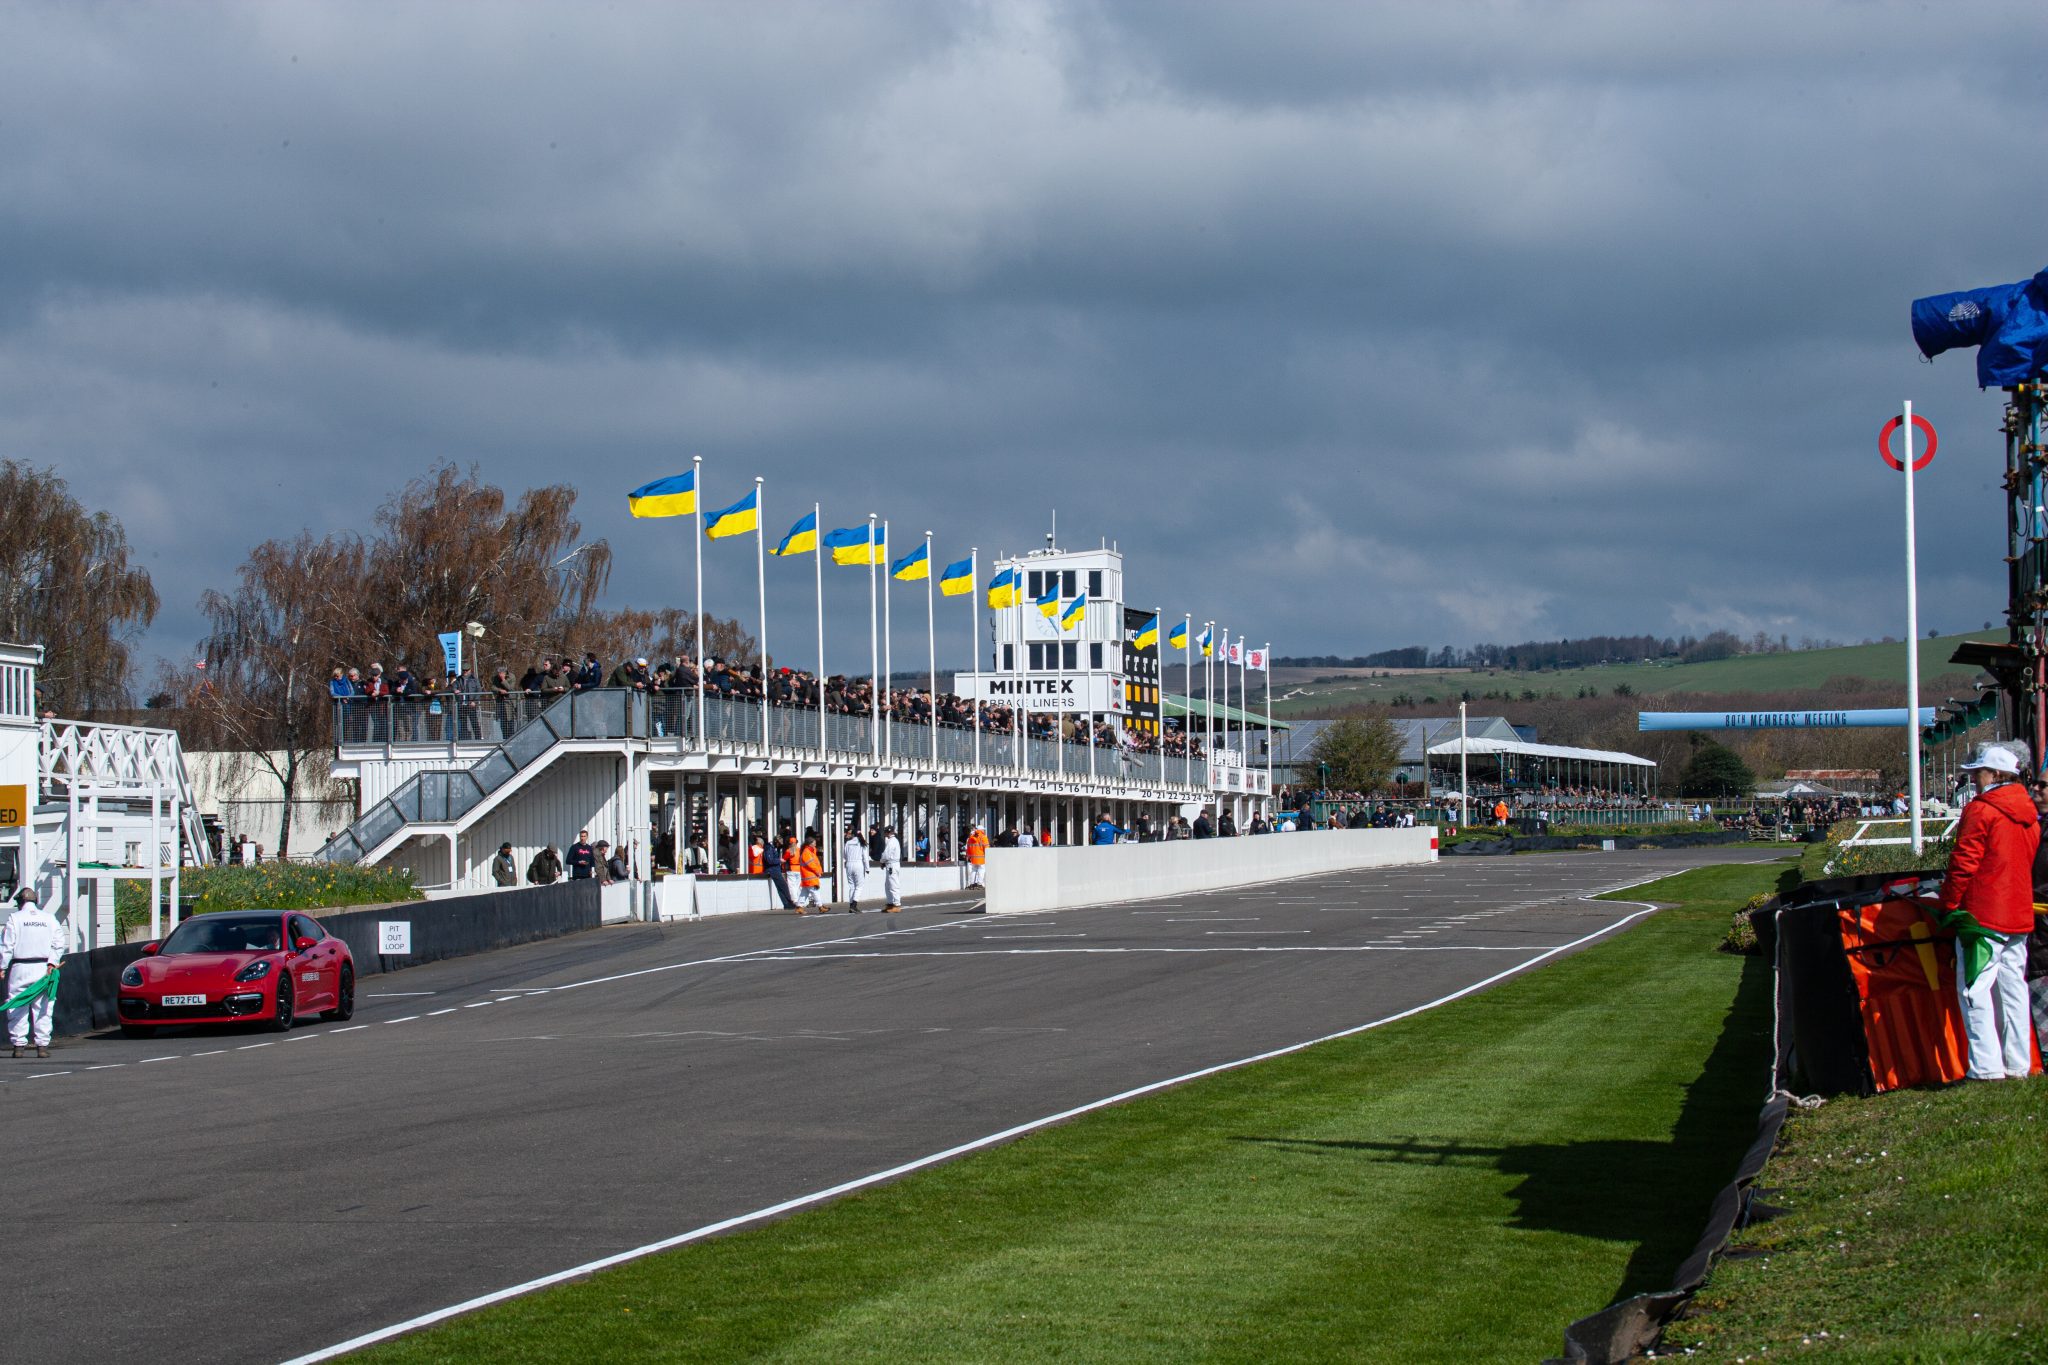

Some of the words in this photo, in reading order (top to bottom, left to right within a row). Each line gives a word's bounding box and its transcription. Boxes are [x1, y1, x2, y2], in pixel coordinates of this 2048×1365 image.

[990, 679, 1074, 694] MINTEX
[1033, 698, 1075, 708] LINERS
[1804, 712, 1847, 726] MEETING
[734, 757, 738, 768] 1
[762, 760, 770, 770] 2
[792, 763, 799, 773] 3
[820, 765, 827, 775] 4
[847, 767, 853, 777] 5
[872, 768, 879, 778] 6
[908, 771, 914, 781] 7
[931, 772, 938, 782] 8
[954, 775, 960, 784] 9
[969, 777, 980, 786] 10
[991, 778, 1000, 787] 11
[1009, 780, 1019, 788] 12
[1035, 782, 1046, 790] 14
[1053, 783, 1064, 792] 15
[1069, 785, 1080, 793] 16
[1085, 786, 1095, 794] 17
[1100, 787, 1111, 795] 18
[1116, 788, 1126, 796] 19
[1141, 790, 1152, 798] 20
[1168, 792, 1178, 800] 22
[1182, 793, 1191, 801] 23
[165, 996, 186, 1005] RE72
[187, 995, 203, 1004] FCL
